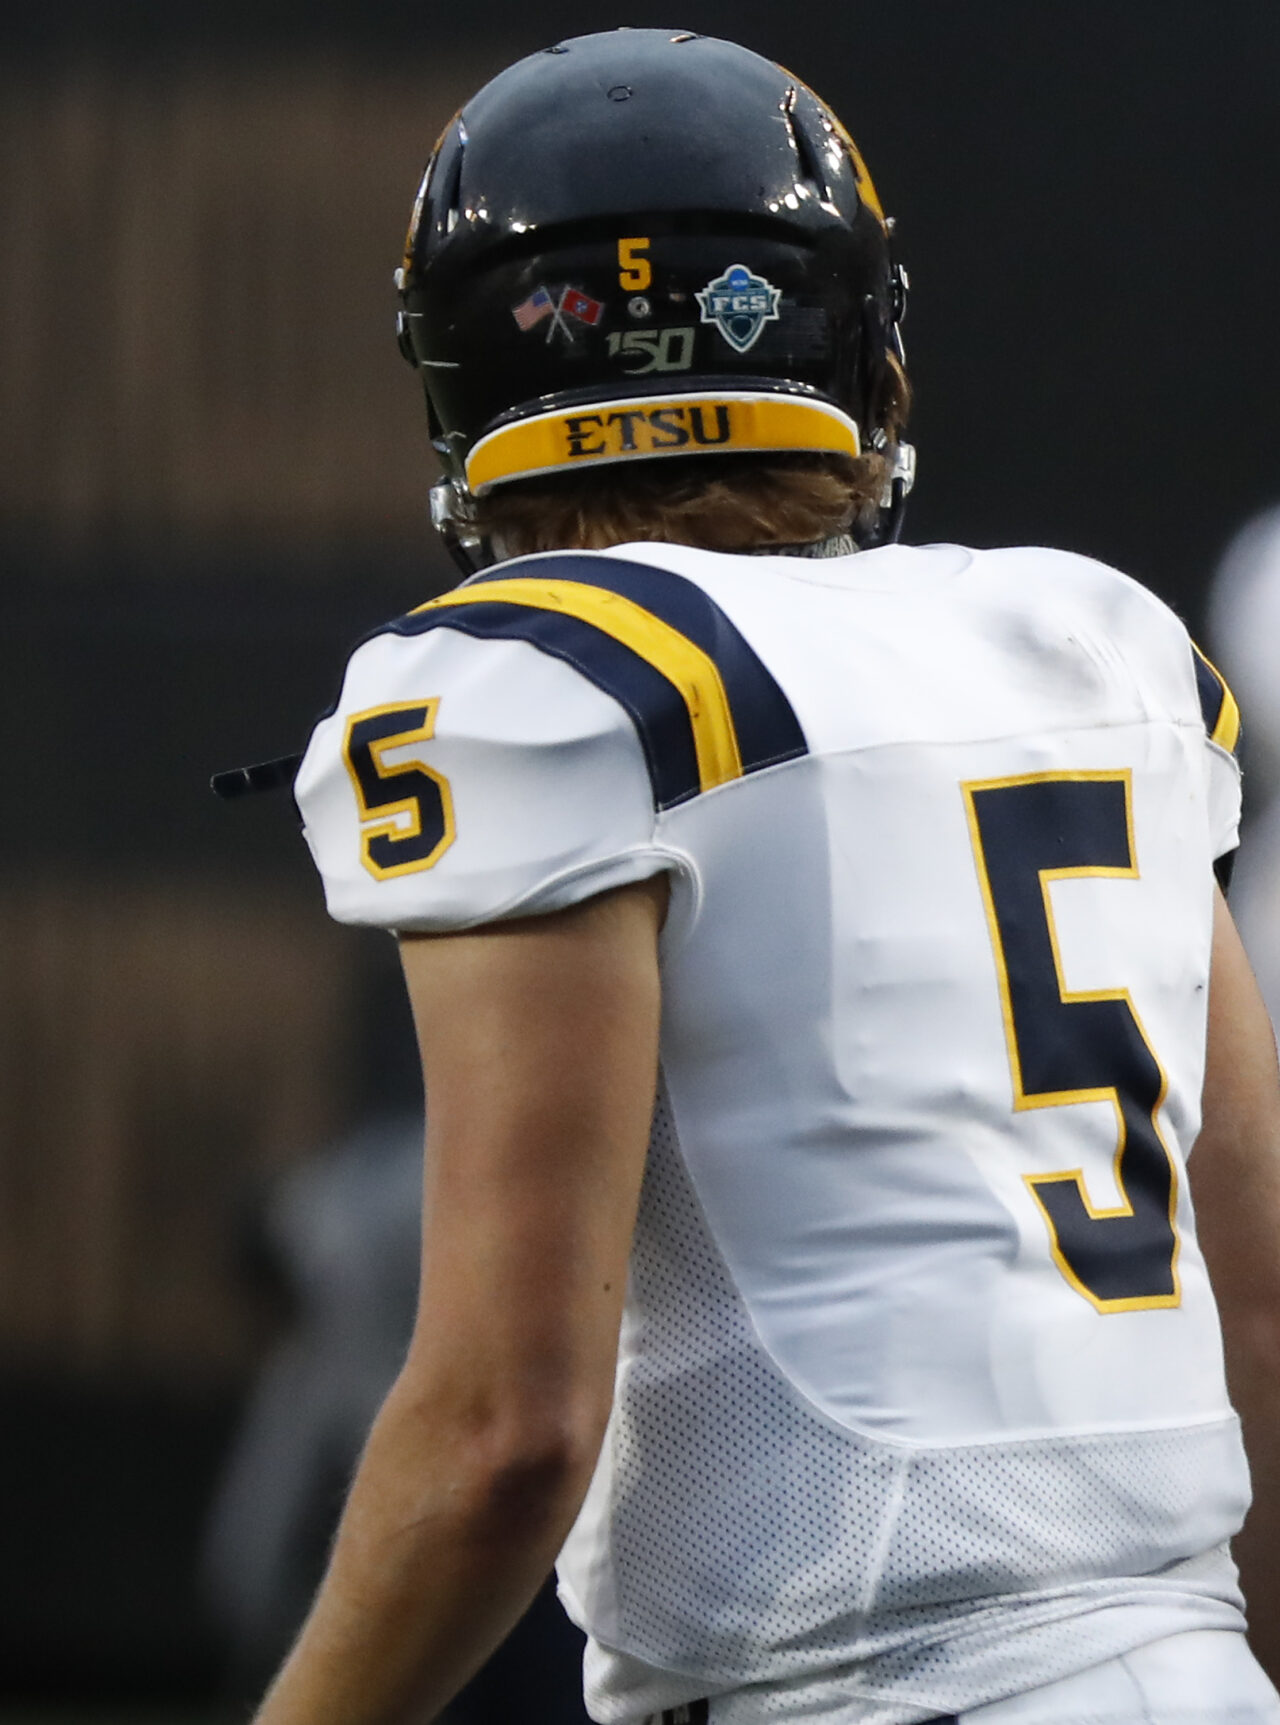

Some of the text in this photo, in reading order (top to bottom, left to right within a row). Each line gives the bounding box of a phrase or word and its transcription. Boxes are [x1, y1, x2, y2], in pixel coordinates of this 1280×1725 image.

[618, 237, 651, 291] 5
[712, 295, 767, 312] FCS
[606, 327, 695, 374] 150
[565, 405, 732, 456] ETSU
[341, 697, 456, 881] 5
[960, 768, 1181, 1314] 5
